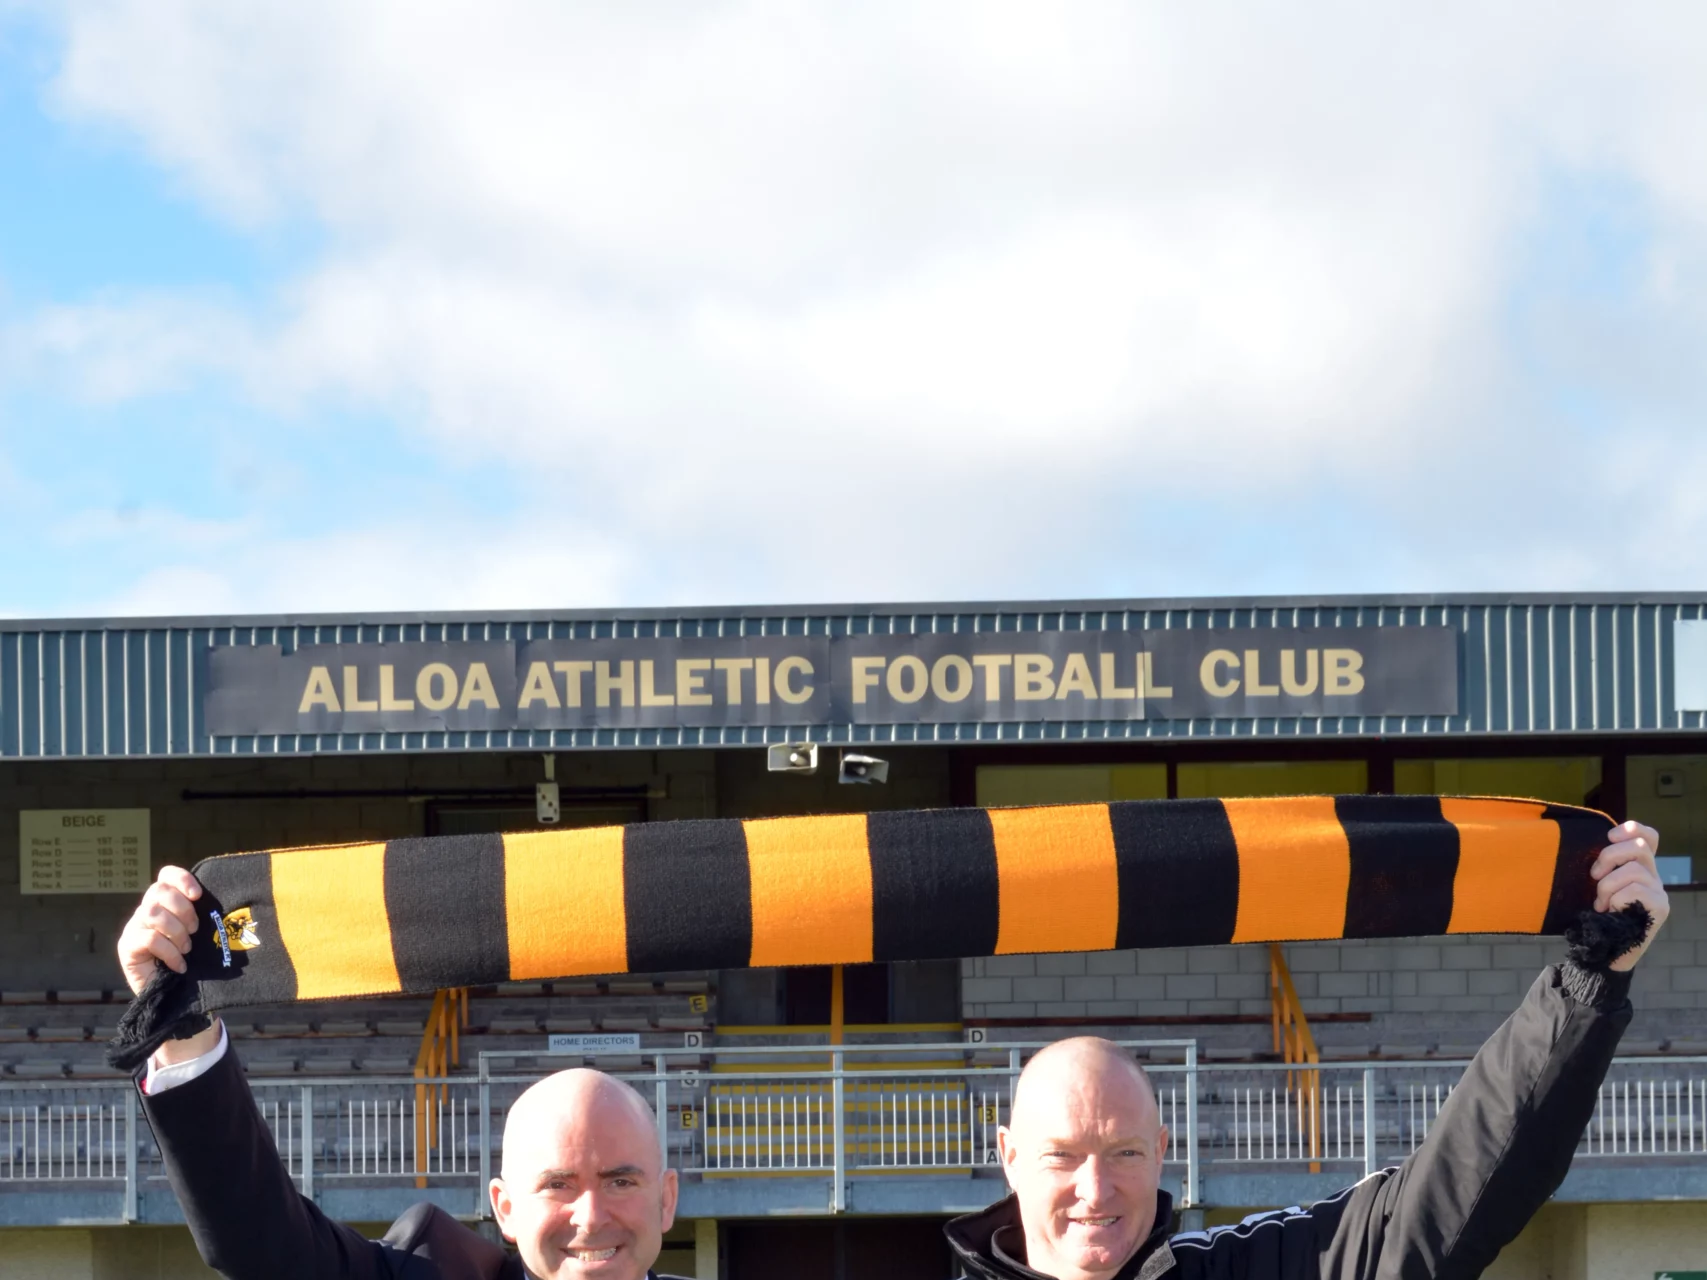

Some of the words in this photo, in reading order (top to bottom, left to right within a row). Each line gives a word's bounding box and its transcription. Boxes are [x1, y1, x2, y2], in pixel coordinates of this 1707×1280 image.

[298, 662, 500, 714] ALLOA
[517, 655, 814, 709] ATHLETIC
[850, 651, 1173, 704] FOOTBALL
[1199, 648, 1366, 697] CLUB
[62, 815, 106, 828] BEIGE
[31, 837, 52, 846] Row
[31, 849, 52, 857] Row
[31, 860, 52, 868] Row
[32, 870, 52, 879] Row
[32, 881, 52, 890] Row
[692, 997, 704, 1011] E
[553, 1037, 581, 1046] HOME
[582, 1036, 635, 1045] DIRECTORS
[687, 1034, 699, 1048] D
[972, 1030, 983, 1043] D
[987, 1150, 998, 1163] A
